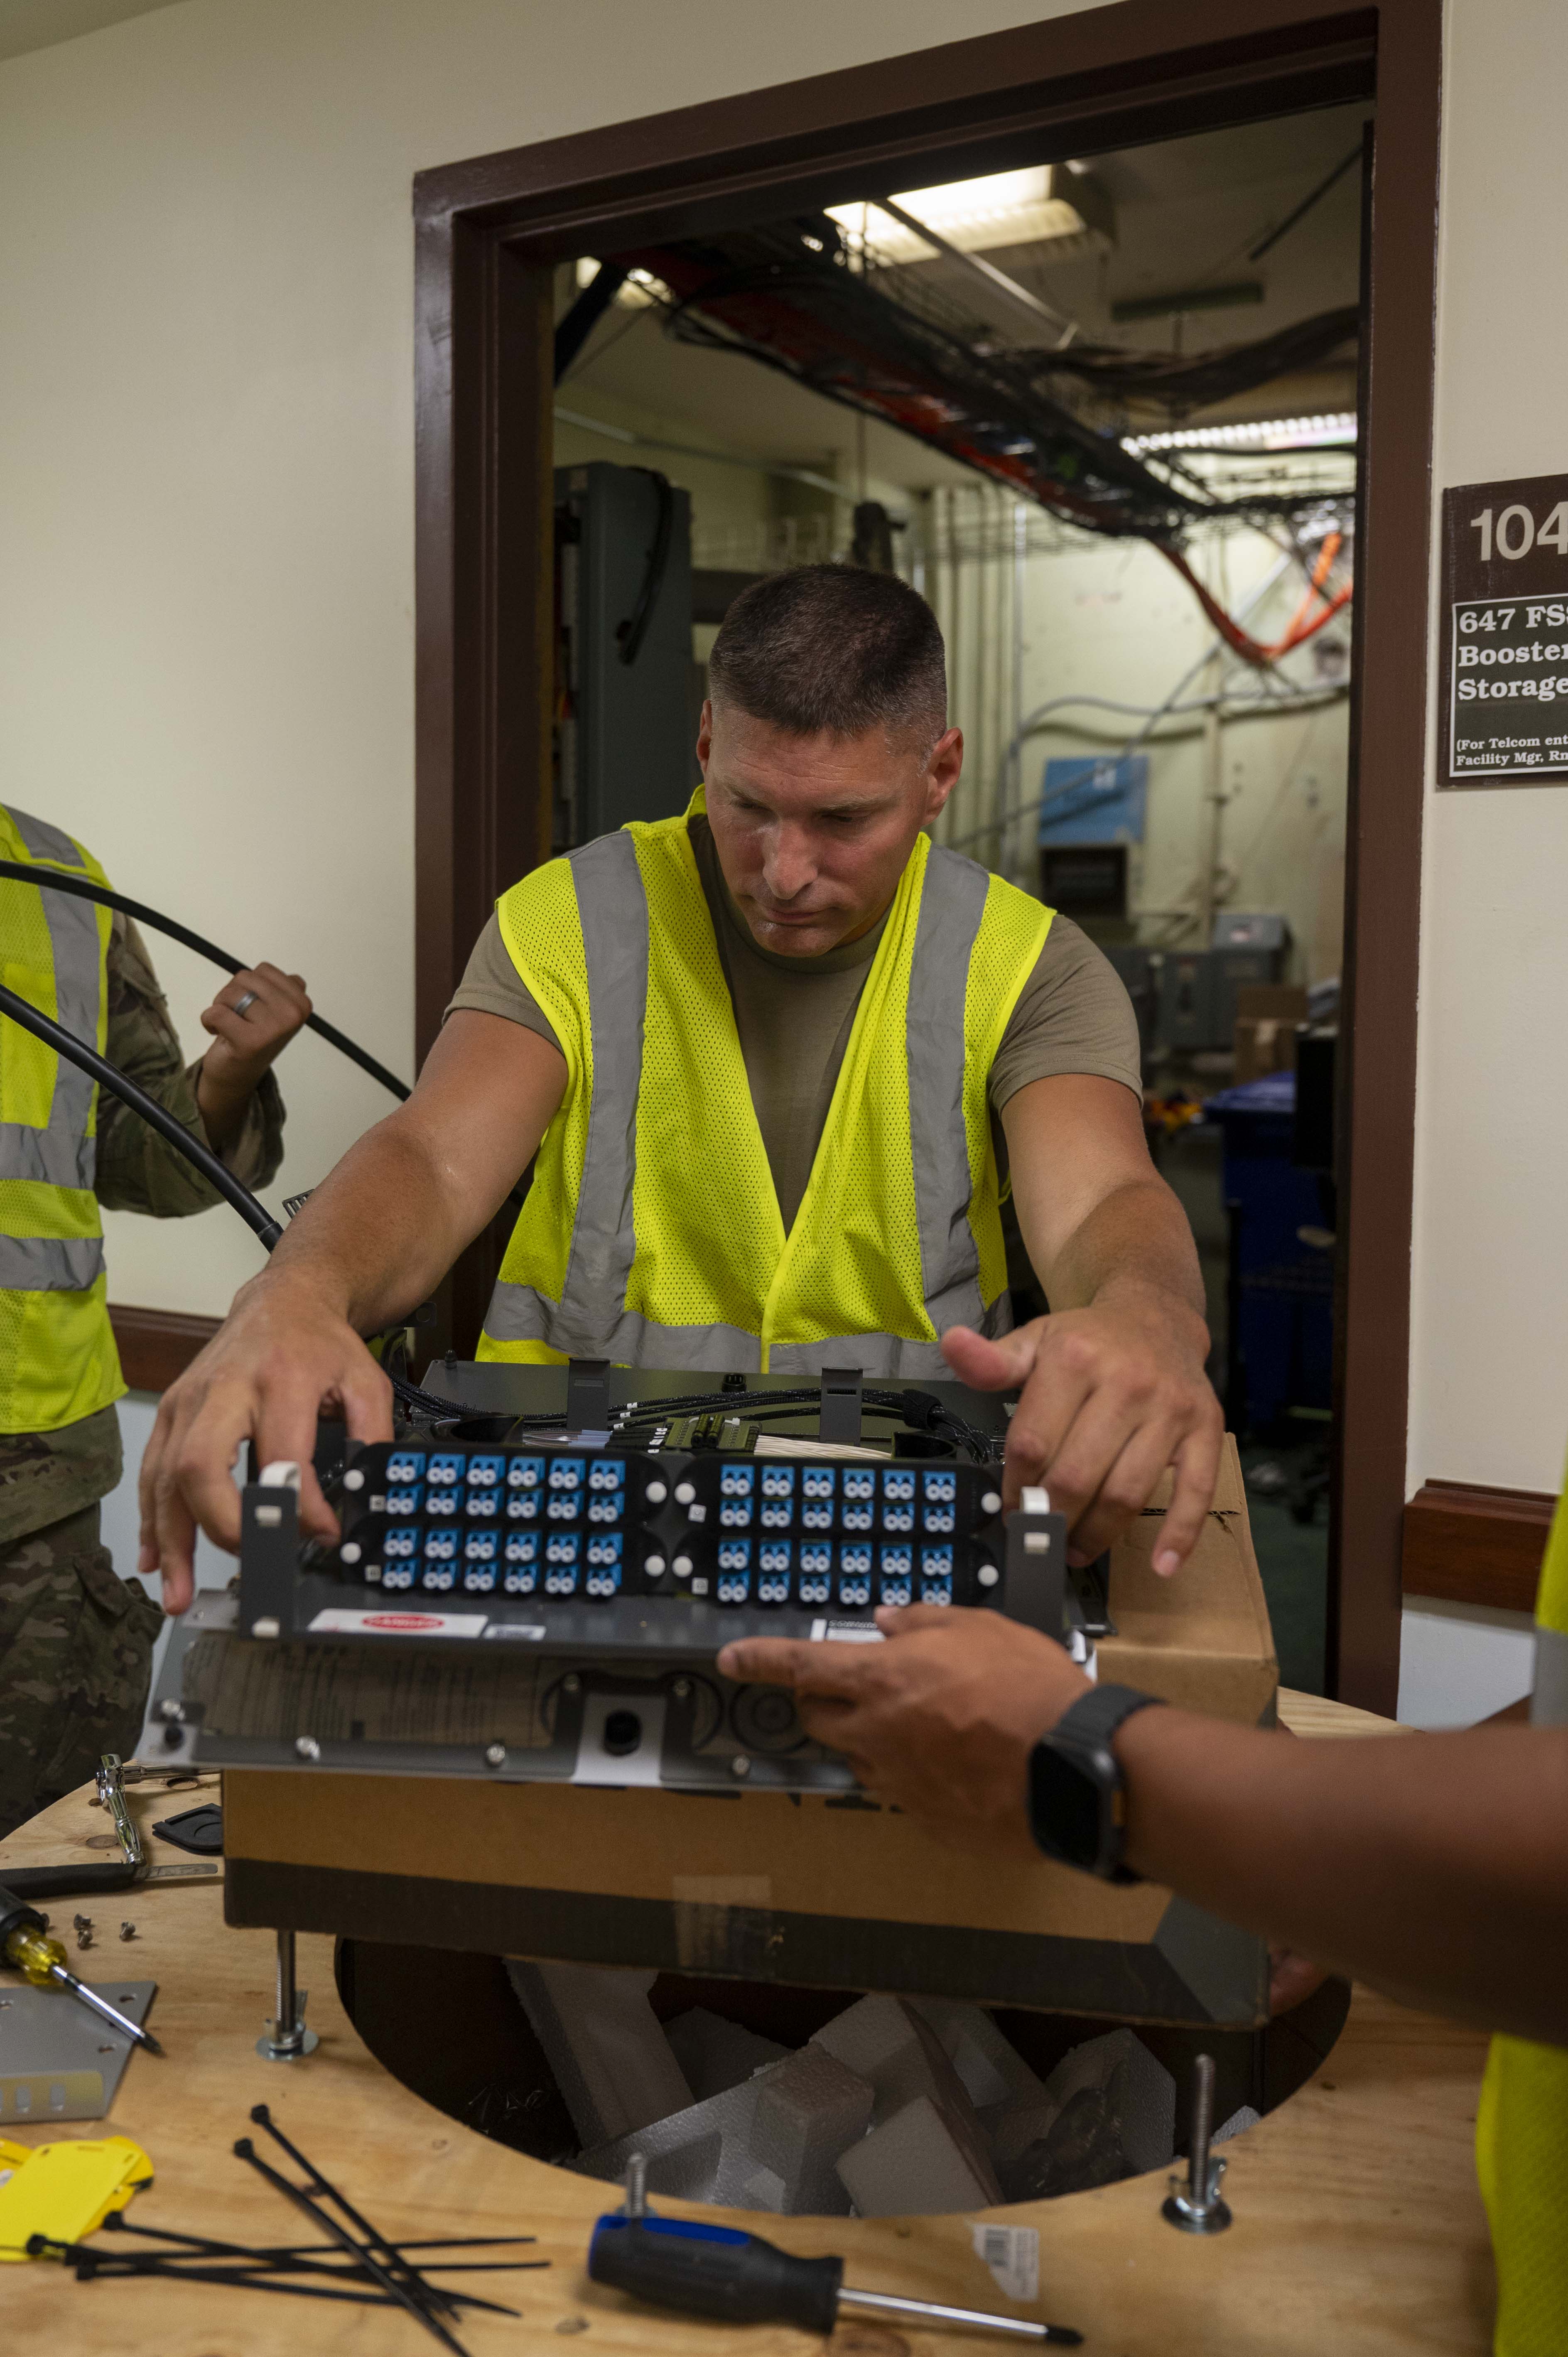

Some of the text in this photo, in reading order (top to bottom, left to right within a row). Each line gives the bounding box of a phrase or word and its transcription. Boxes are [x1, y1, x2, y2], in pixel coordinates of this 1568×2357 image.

[1470, 501, 1568, 561] 104
[1459, 608, 1516, 633] 647
[1458, 676, 1568, 701] Storage
[1457, 739, 1485, 751] (For
[1488, 737, 1541, 748] Telcom
[1456, 753, 1510, 766] Facility
